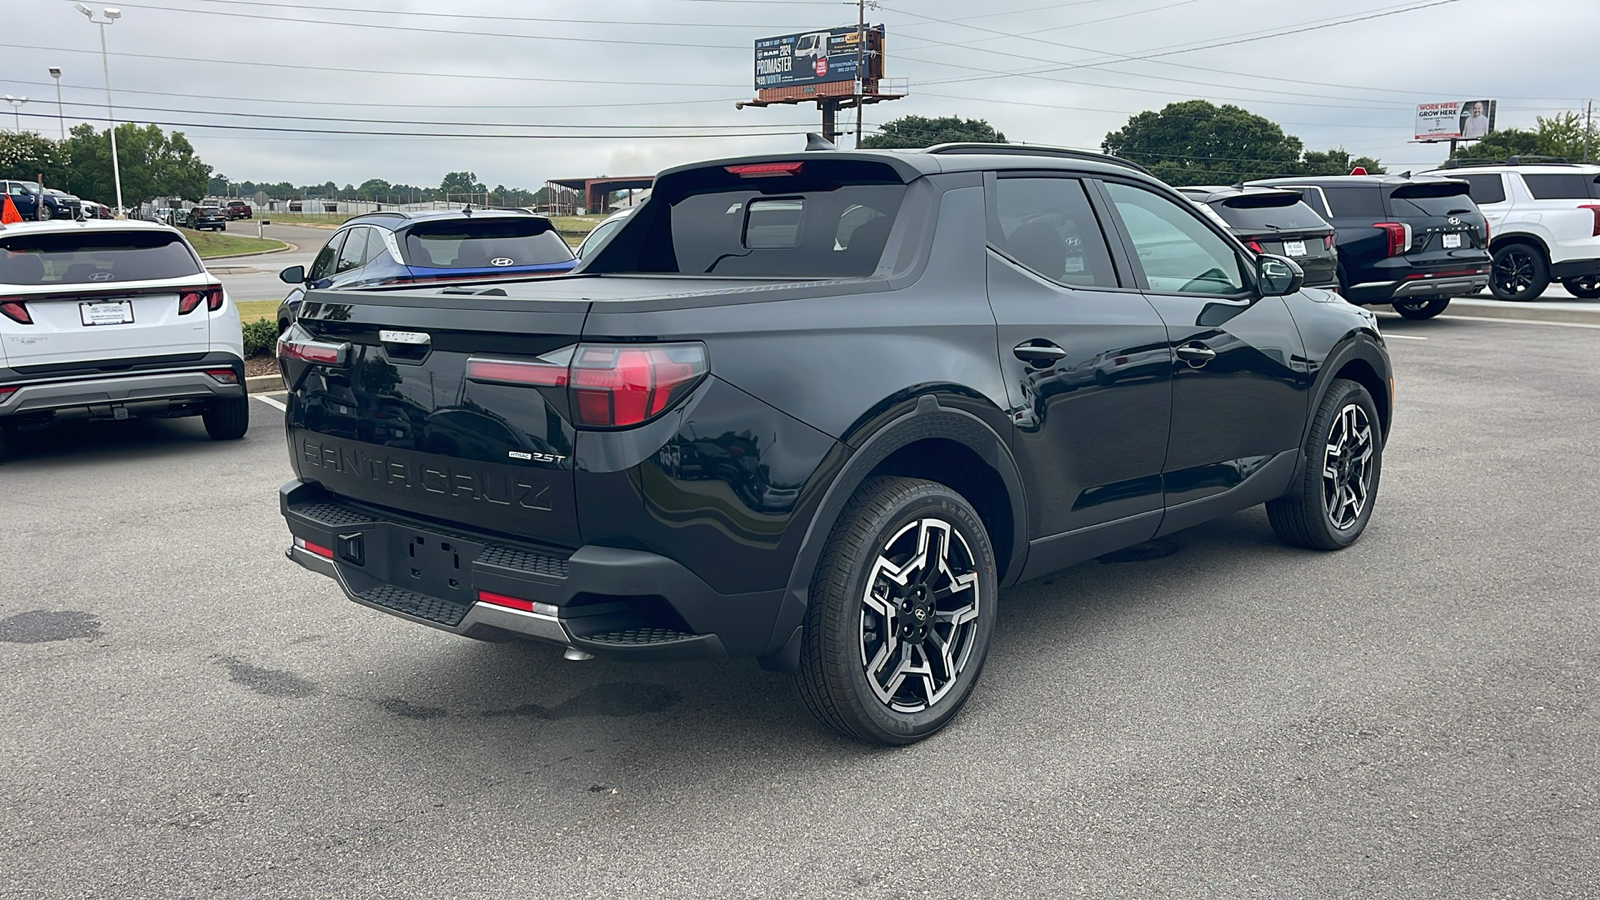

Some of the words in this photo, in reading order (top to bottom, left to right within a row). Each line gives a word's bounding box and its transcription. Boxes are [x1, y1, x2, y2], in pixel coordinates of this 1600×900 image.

[757, 56, 792, 75] PROMASTER
[780, 44, 791, 57] 2024
[303, 438, 412, 488] SANTA
[420, 462, 553, 512] CRUZ
[958, 508, 991, 562] MICHELIN
